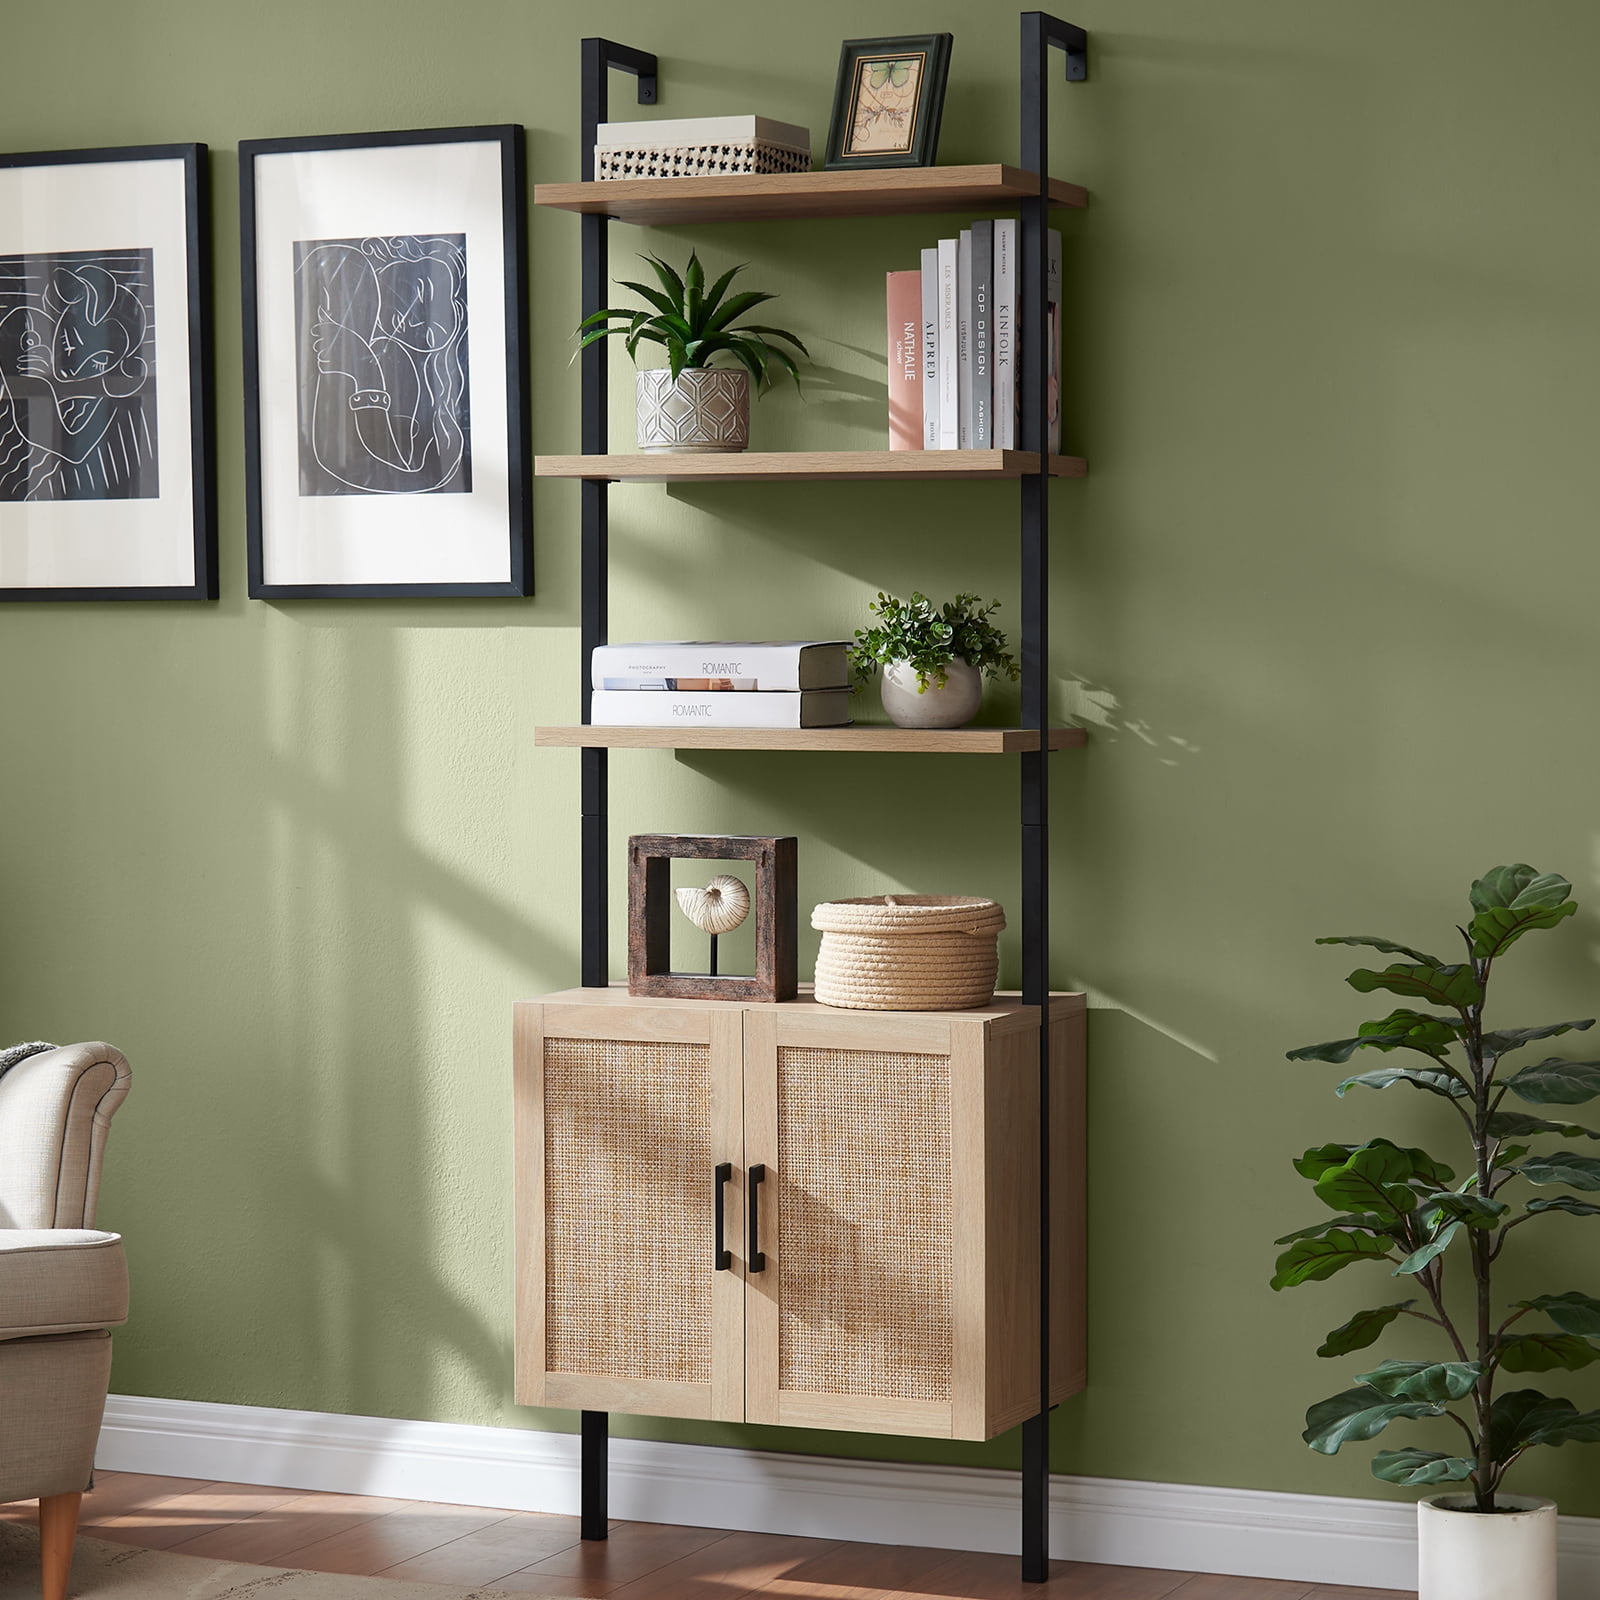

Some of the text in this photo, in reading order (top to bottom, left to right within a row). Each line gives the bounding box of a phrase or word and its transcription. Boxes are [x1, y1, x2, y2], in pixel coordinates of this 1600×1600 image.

[944, 283, 952, 330] MISERABLES
[977, 284, 986, 376] TOP DESIGN
[999, 304, 1009, 367] KINFOLK
[903, 321, 916, 381] NATHALIE
[926, 321, 936, 379] ALPRED
[702, 662, 742, 675] ROMANTIC
[672, 704, 712, 717] ROMANTIC
